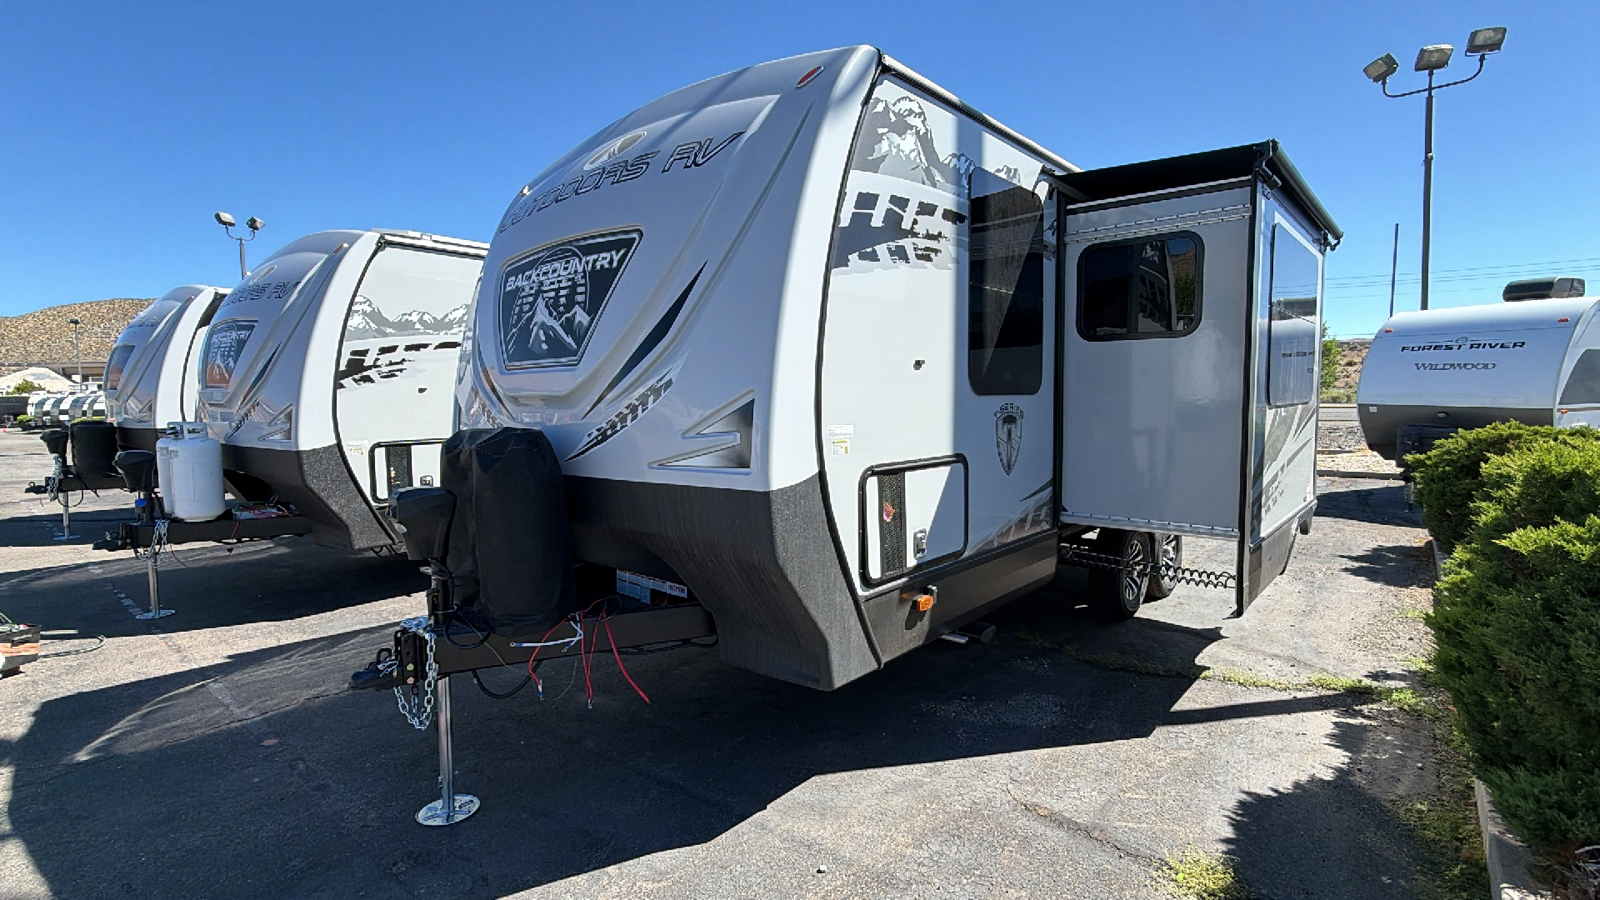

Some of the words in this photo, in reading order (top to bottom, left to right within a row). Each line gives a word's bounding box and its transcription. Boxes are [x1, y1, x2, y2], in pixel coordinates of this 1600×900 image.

[661, 131, 747, 174] RV
[505, 248, 627, 292] BACKCOUNTRY
[1401, 343, 1467, 352] FOREST
[1469, 341, 1526, 350] RIVER
[1414, 362, 1497, 371] WILDWOOD
